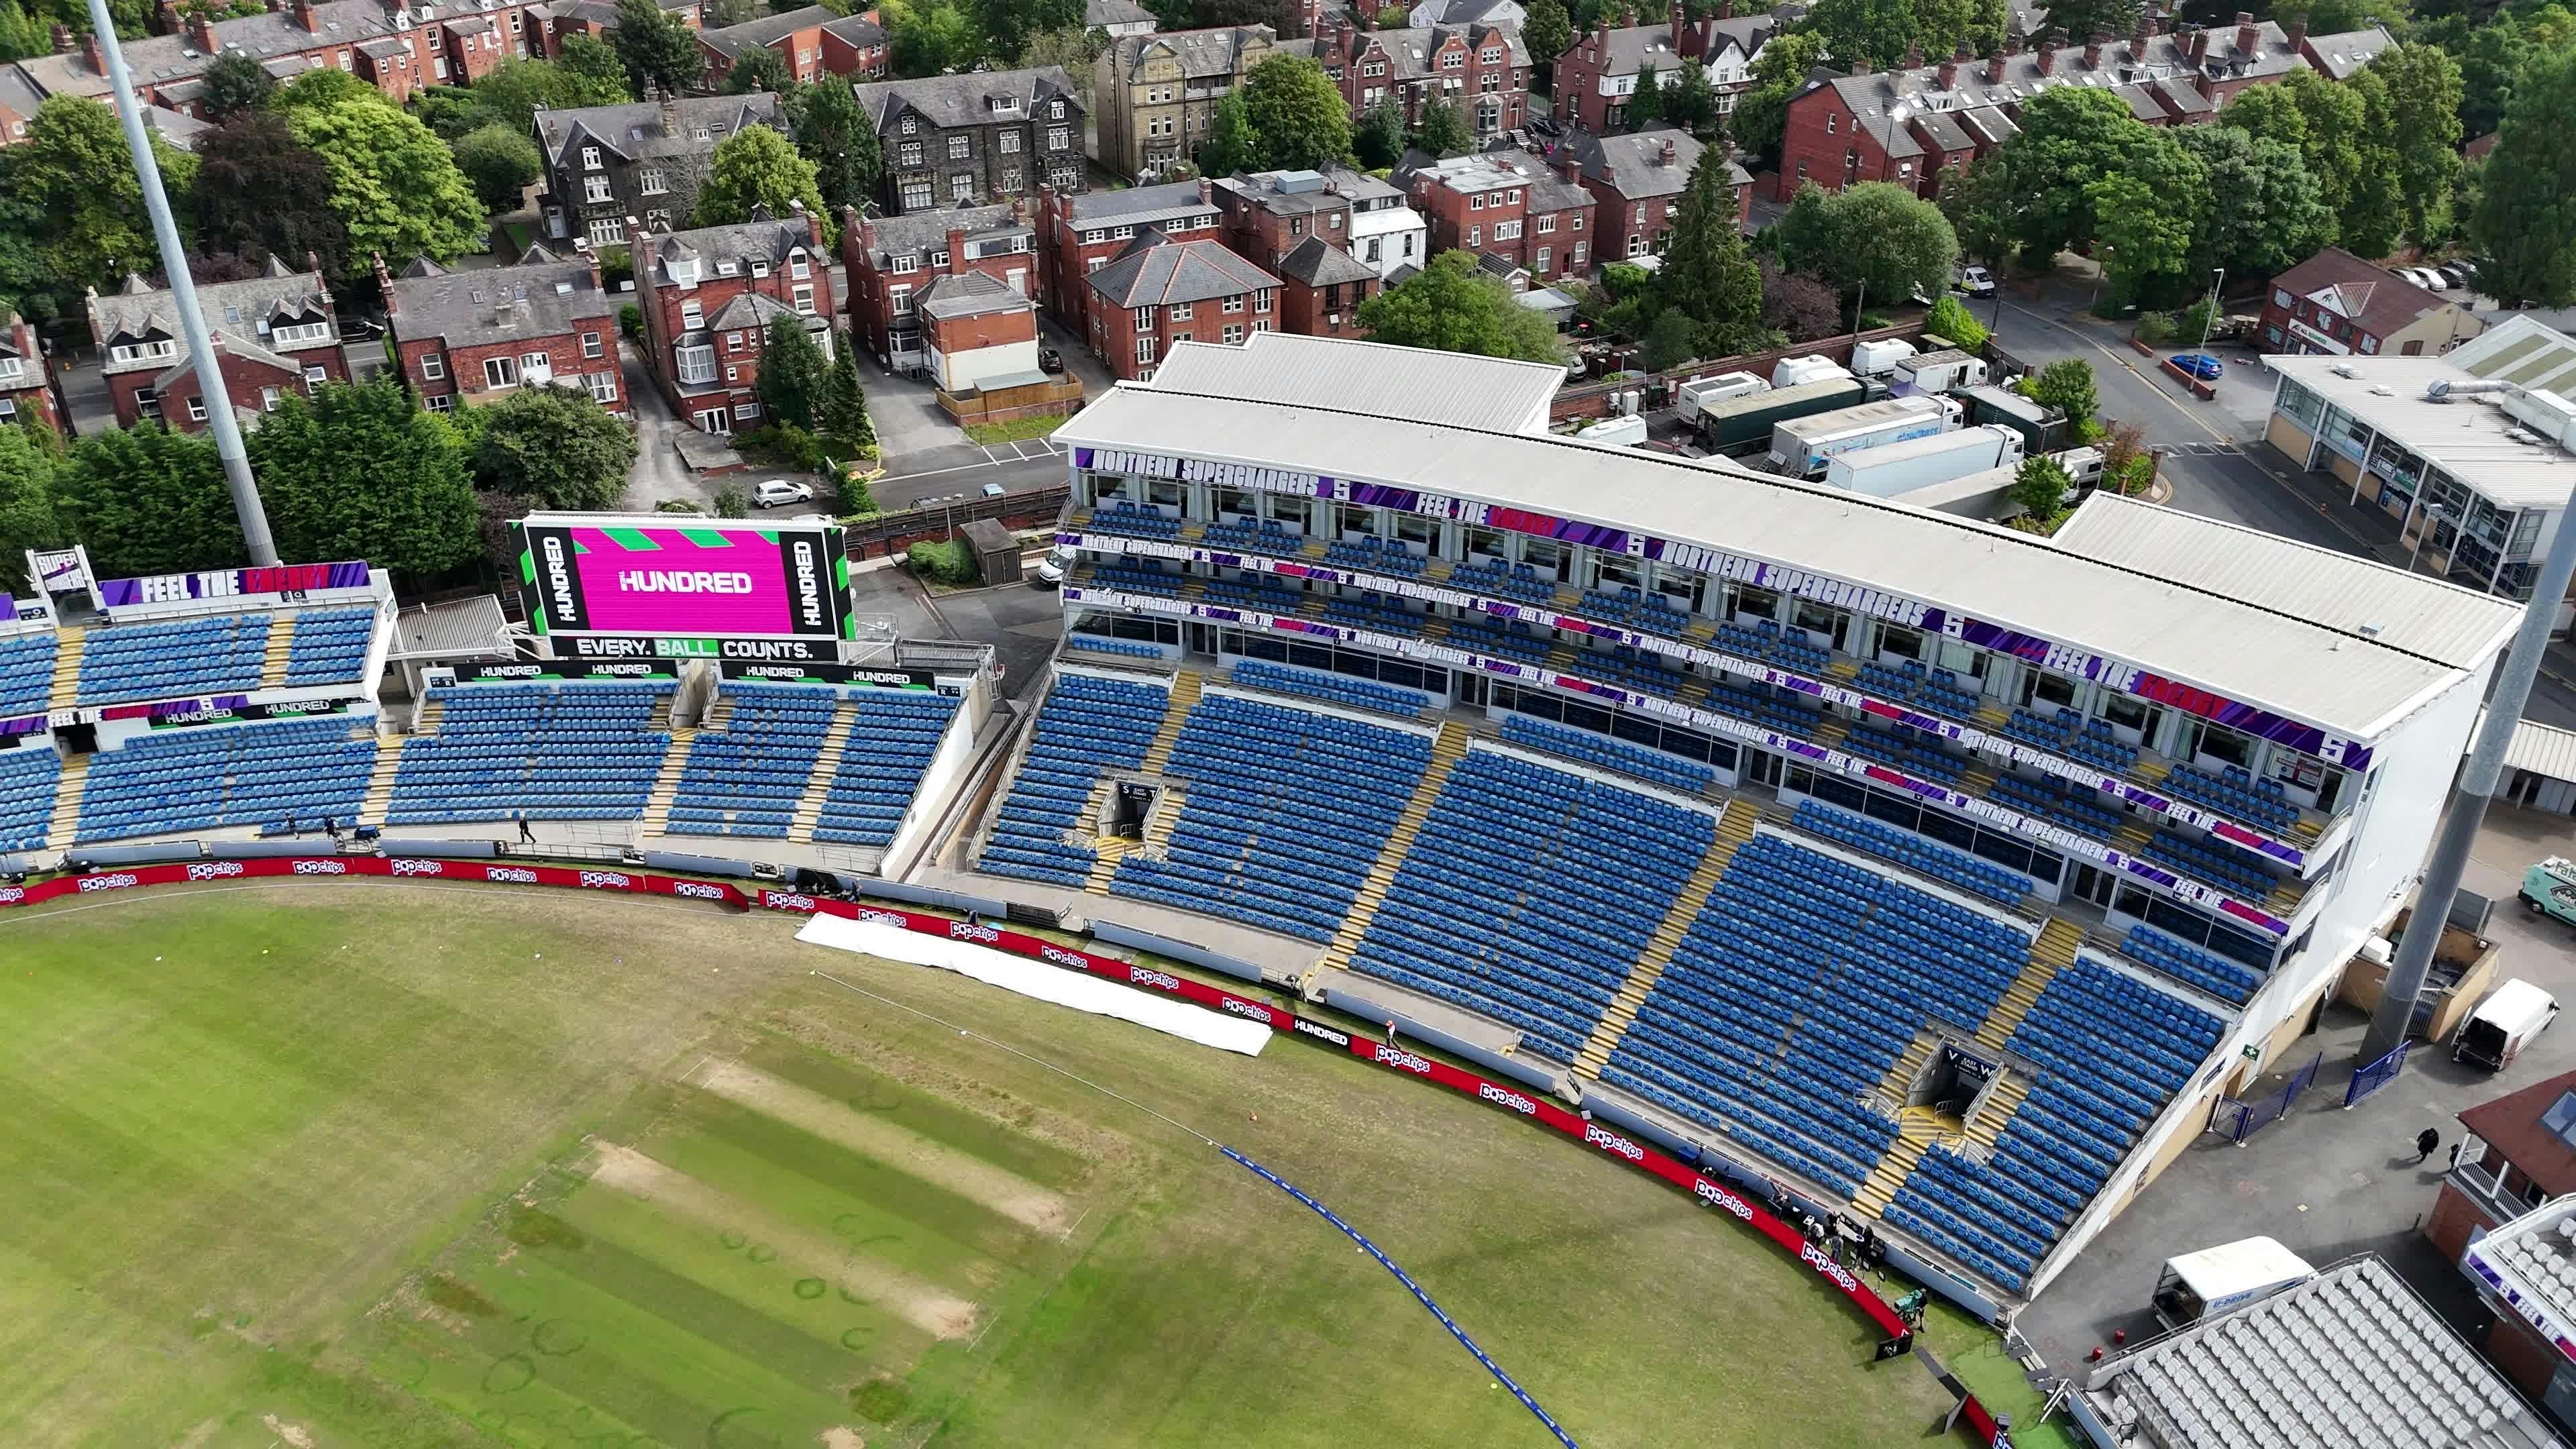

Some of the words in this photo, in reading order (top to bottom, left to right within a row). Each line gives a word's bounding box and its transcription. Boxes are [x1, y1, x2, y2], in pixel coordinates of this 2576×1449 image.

[1093, 449, 1178, 478] NORTHERN
[1182, 458, 1319, 496] SUPERCHARGERS
[1415, 492, 1451, 519] FEEL
[1456, 499, 1487, 525] THE
[1082, 537, 1124, 551] NORTHERN
[1126, 541, 1194, 561] SUPERCHARGERS
[37, 553, 78, 576] SUPER
[1240, 557, 1257, 570] FEEL
[1260, 559, 1275, 570] THE
[142, 576, 191, 603] FEEL
[198, 571, 239, 597] THE
[543, 537, 576, 621] HUNDRED
[622, 571, 752, 594] HUNDRED
[794, 541, 822, 626] HUNDRED
[1660, 541, 1760, 583] NORTHERN
[1762, 564, 1927, 627] SUPERCHARGERS
[1354, 576, 1398, 594] NORTHERN
[1399, 584, 1471, 607] SUPERCHARGERS
[1124, 596, 1191, 615] SUPERCHARGERS
[1240, 612, 1257, 625] FEEL
[1258, 615, 1273, 627] THE
[1518, 608, 1536, 622] FEEL
[1540, 612, 1556, 627] THE
[577, 639, 651, 656] EVERY.
[655, 639, 718, 657] BALL.
[723, 641, 814, 659] COUNTS.
[1354, 632, 1397, 650] NORTHERN
[592, 664, 652, 675] HUNDRED
[1641, 637, 1688, 659] NORTHERN
[1689, 649, 1768, 680] SUPERCHARGERS
[2043, 643, 2092, 680] FEEL
[2094, 658, 2138, 692] THE
[481, 665, 542, 678] HUNDRED
[746, 665, 804, 678] HUNDRED
[853, 671, 910, 684] HUNDRED
[1519, 667, 1537, 681] FEEL
[1541, 672, 1556, 686] THE
[265, 700, 330, 714] HUNDRED
[1820, 686, 1842, 703] FEEL
[1846, 692, 1863, 708] THE
[48, 712, 76, 727] FEEL
[78, 709, 102, 724] THE
[166, 708, 233, 724] HUNDRED
[1644, 696, 1692, 720] NORTHERN
[1691, 710, 1770, 744] SUPERCHARGERS
[1825, 751, 1847, 769] FEEL
[1848, 759, 1867, 775] THE
[2013, 747, 2104, 788] SUPERCHARGERS
[1123, 786, 1130, 794] S
[1149, 790, 1156, 798] T
[2167, 803, 2190, 822] FEEL
[2194, 812, 2216, 829] THE
[1964, 798, 2021, 828] NORTHERN
[2019, 817, 2110, 861] SUPERCHARGERS
[187, 861, 243, 881] popchips
[293, 860, 345, 875] popchips
[392, 859, 442, 875] popchips
[487, 867, 537, 883] popchips
[78, 875, 137, 892] popchips
[581, 872, 629, 887] popchips
[674, 882, 723, 900] popchips
[767, 892, 815, 910] popchips
[2173, 879, 2198, 898] FEEL
[2198, 890, 2224, 908] THE
[951, 921, 998, 941] popchips
[1042, 945, 1087, 968] popchips
[1131, 966, 1179, 989] popchips
[1223, 997, 1271, 1022] popchips
[1295, 1019, 1348, 1046] HUNDRED
[1376, 1044, 1430, 1073] popchips
[1949, 1049, 1958, 1061] V
[1980, 1064, 1995, 1077] W
[1480, 1083, 1536, 1114] popchips
[1586, 1123, 1644, 1160] popchips
[1695, 1179, 1754, 1220] popchips
[1802, 1240, 1856, 1292] popchips
[2516, 1299, 2544, 1322] FEEL
[2538, 1318, 2563, 1343] THE
